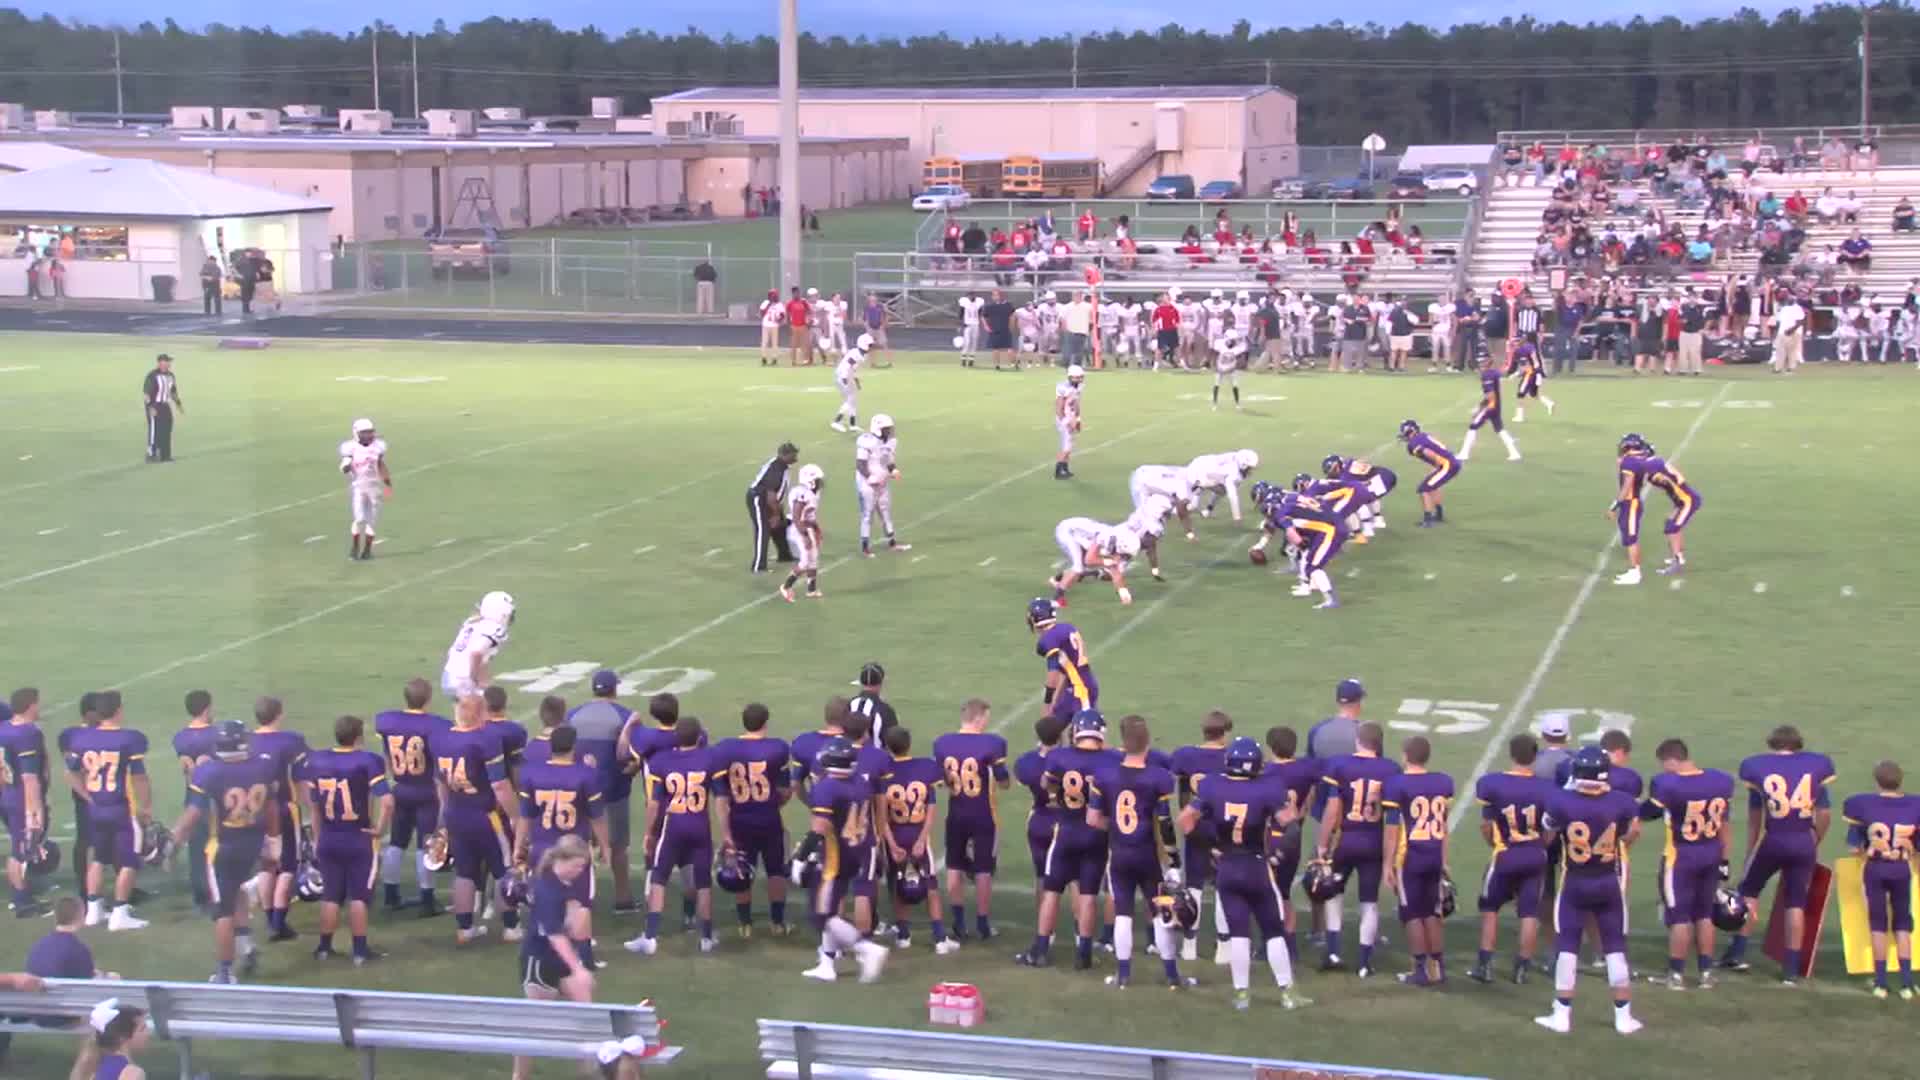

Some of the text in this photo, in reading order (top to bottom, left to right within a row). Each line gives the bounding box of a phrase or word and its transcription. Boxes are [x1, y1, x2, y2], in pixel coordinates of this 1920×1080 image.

[318, 778, 360, 821] 71
[535, 789, 577, 831] 75
[665, 771, 706, 814] 25
[1116, 789, 1139, 834] 6
[1224, 801, 1248, 844] 7
[1501, 804, 1540, 842] 11
[1567, 821, 1617, 863] 84
